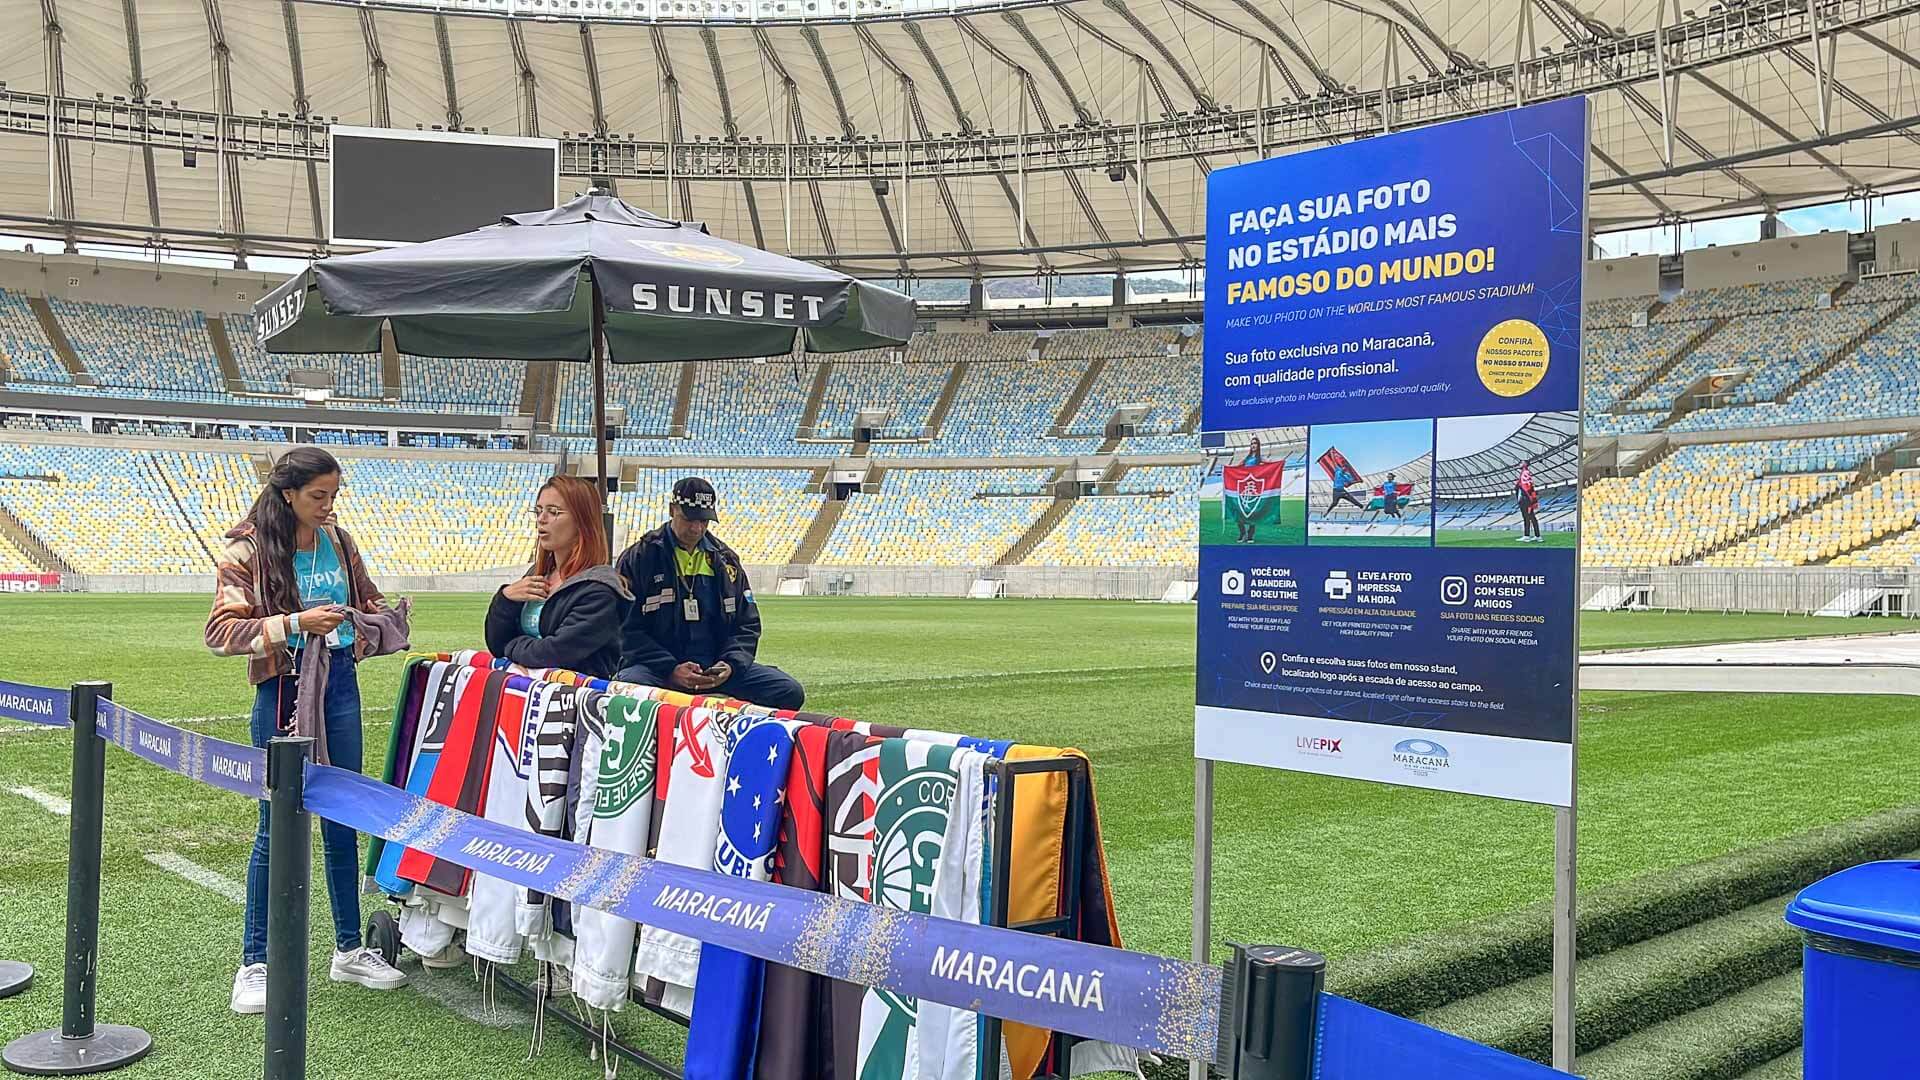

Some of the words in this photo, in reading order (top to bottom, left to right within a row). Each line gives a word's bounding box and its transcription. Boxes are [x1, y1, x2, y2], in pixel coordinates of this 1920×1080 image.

[1229, 204, 1293, 234] FAÇA
[1298, 194, 1352, 222] SUA
[1357, 179, 1430, 212] FOTO
[1228, 245, 1260, 269] NO
[1266, 226, 1378, 264] ESTÁDIO
[1384, 214, 1456, 246] MAIS
[1227, 270, 1329, 304] FAMOSO
[1335, 265, 1373, 290] DO
[1379, 247, 1494, 284] MUNDO!
[632, 283, 824, 320] SUNSET
[1225, 317, 1249, 328] MAKE
[1252, 314, 1271, 325] YOU
[1273, 310, 1305, 322] PHOTO
[1308, 308, 1323, 318] ON
[1326, 305, 1345, 316] THE
[1347, 299, 1392, 313] WORLD'S
[1395, 295, 1425, 308] MOST
[1427, 290, 1475, 304] FAMOUS
[1477, 283, 1534, 299] STADIUM!
[257, 289, 302, 340] SUNSET
[1224, 352, 1248, 364] Sua
[1250, 349, 1275, 362] foto
[1278, 343, 1337, 359] exclusiva
[1341, 342, 1358, 353] no
[1361, 332, 1434, 351] Maracanã,
[1498, 337, 1533, 345] CONFIRA
[1224, 376, 1249, 386] com
[1253, 367, 1314, 386] qualidade
[1317, 359, 1399, 381] profissional.
[1251, 567, 1271, 577] VOCÊ
[1272, 568, 1290, 577] COM
[1357, 572, 1379, 580] LEVE
[1380, 572, 1387, 581] A
[1388, 572, 1412, 581] FOTO
[1474, 574, 1545, 585] COMPARTILHE
[1251, 579, 1257, 587] A
[1258, 580, 1297, 589] BANDEIRA
[1251, 590, 1262, 598] DO
[1262, 590, 1279, 599] SEU
[1280, 591, 1298, 599] TIME
[1357, 584, 1402, 593] IMPRESSA
[1474, 587, 1496, 596] COM
[1497, 587, 1525, 597] SEUS
[1371, 596, 1396, 605] HORA
[1474, 599, 1512, 609] AMIGOS
[1455, 612, 1474, 620] FOTO
[1475, 613, 1490, 621] NAS
[1491, 614, 1515, 622] REDES
[1516, 615, 1545, 623] SOCIAIS
[1282, 654, 1308, 663] Confira
[1367, 660, 1387, 669] fotos
[1404, 664, 1428, 672] nosso
[1430, 665, 1457, 674] stand,
[1281, 668, 1318, 678] localizado
[1319, 671, 1336, 681] logo
[1338, 673, 1357, 682] após
[1364, 676, 1393, 684] escada
[1395, 677, 1405, 685] de
[1407, 680, 1436, 688] acesso
[1450, 683, 1483, 694] campo.
[0, 694, 52, 715] MARACANÃ
[139, 730, 171, 757] MARACANÃ
[1297, 736, 1342, 752] LIVEPIX
[212, 754, 251, 783] MARACANÃ
[460, 837, 555, 875] MARACANÃ
[652, 885, 776, 932] MARACANÃ
[930, 946, 1104, 1011] MARACANÃ
